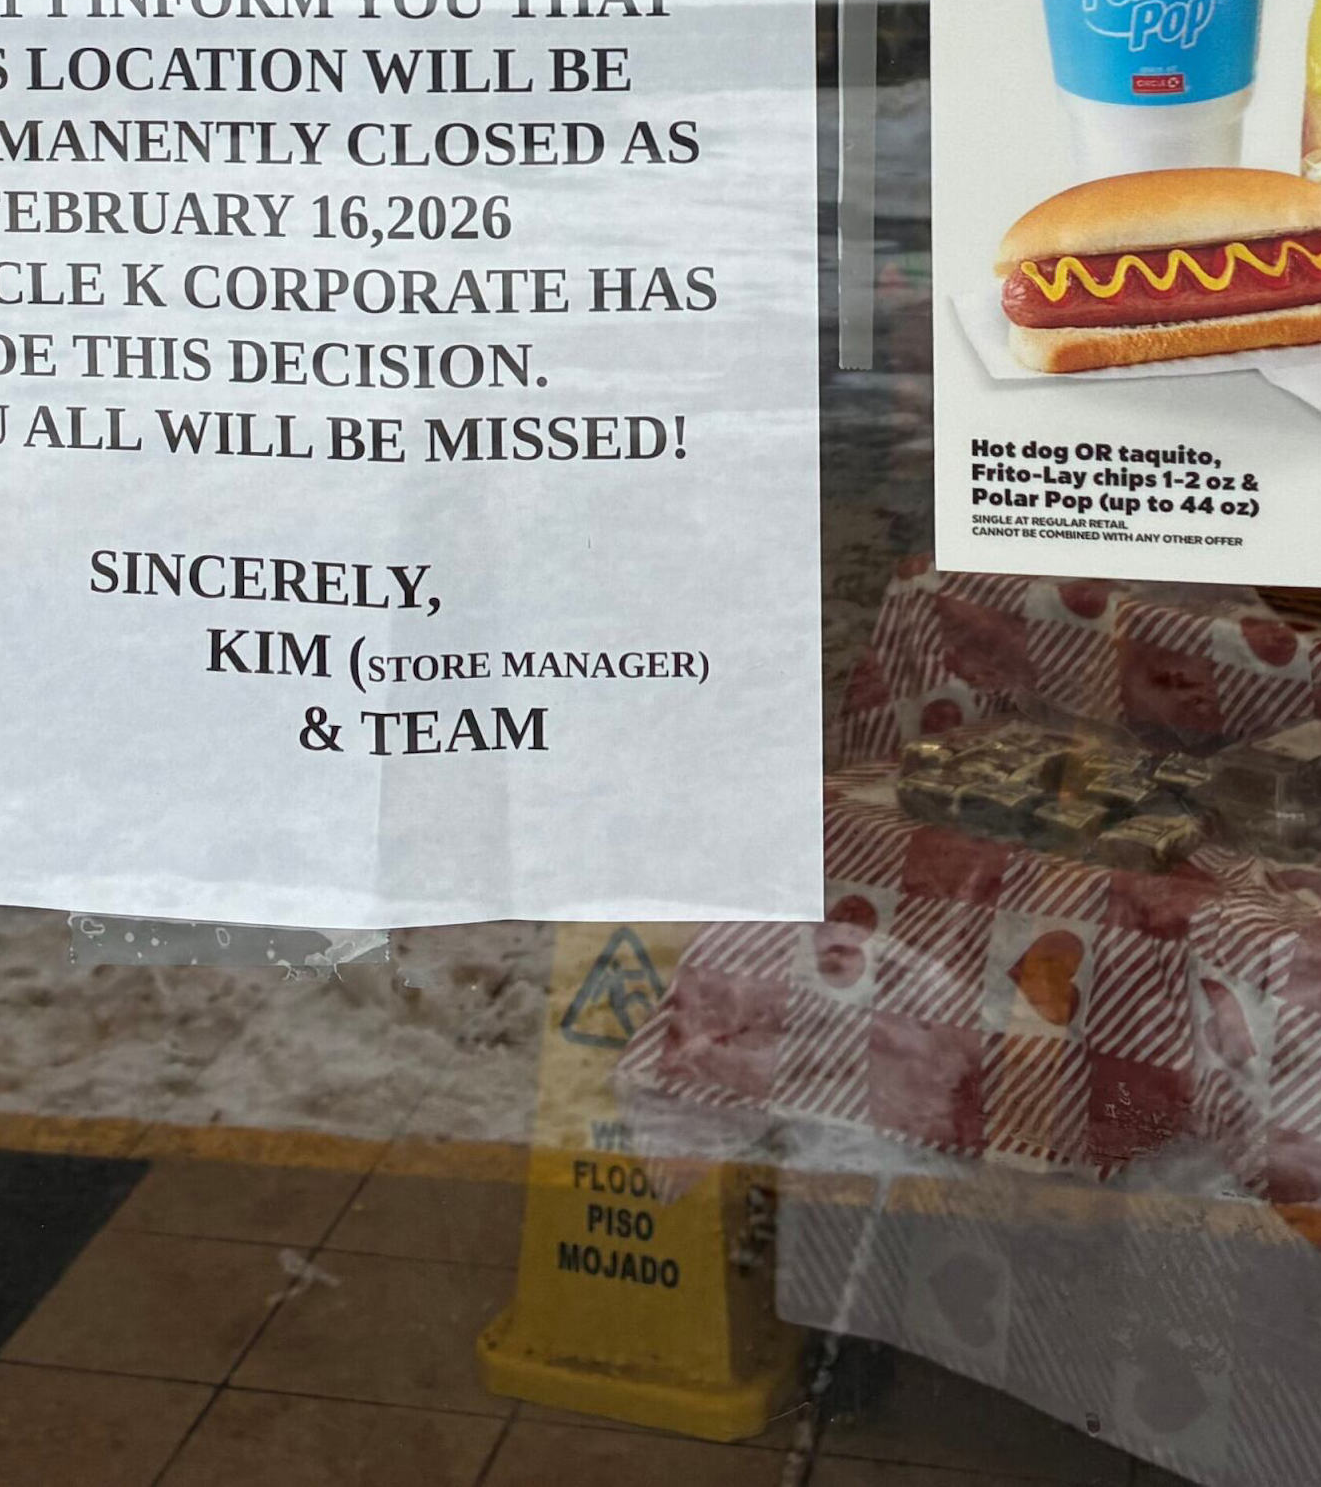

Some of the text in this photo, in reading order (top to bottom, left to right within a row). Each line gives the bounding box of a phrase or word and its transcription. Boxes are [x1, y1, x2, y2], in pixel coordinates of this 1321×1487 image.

[25, 47, 348, 94] LOCATION
[362, 48, 534, 95] WILL
[547, 47, 633, 93] BE
[346, 121, 606, 167] CLOSED
[620, 120, 701, 165] AS
[312, 194, 512, 249] 16,2026
[121, 263, 168, 307] K
[184, 264, 569, 315] CORPORATE
[588, 266, 718, 313] HAS
[72, 334, 212, 382] THIS
[227, 339, 549, 389] DECISION.
[23, 405, 143, 451] ALL
[154, 409, 314, 460] WILL
[326, 417, 406, 463] BE
[424, 415, 688, 463] MISSED!
[971, 439, 1222, 469] Hot dog OR taquito,
[971, 463, 1259, 492] Frito-Lay chips 1-2 oz &
[971, 487, 1260, 518] Polar Pop (up to 44 oz)
[972, 514, 1129, 530] SINGLE AT REGULAR RETAIL
[971, 526, 1244, 547] CANNOT BE COMBINED WITH ANY OTHER OFFER
[90, 549, 442, 619] SINCERELY,
[205, 628, 710, 694] KIM (STORE MANAGER)
[298, 706, 550, 756] & TEAM
[586, 1203, 654, 1242] PISO
[557, 1241, 680, 1289] MOJADO
